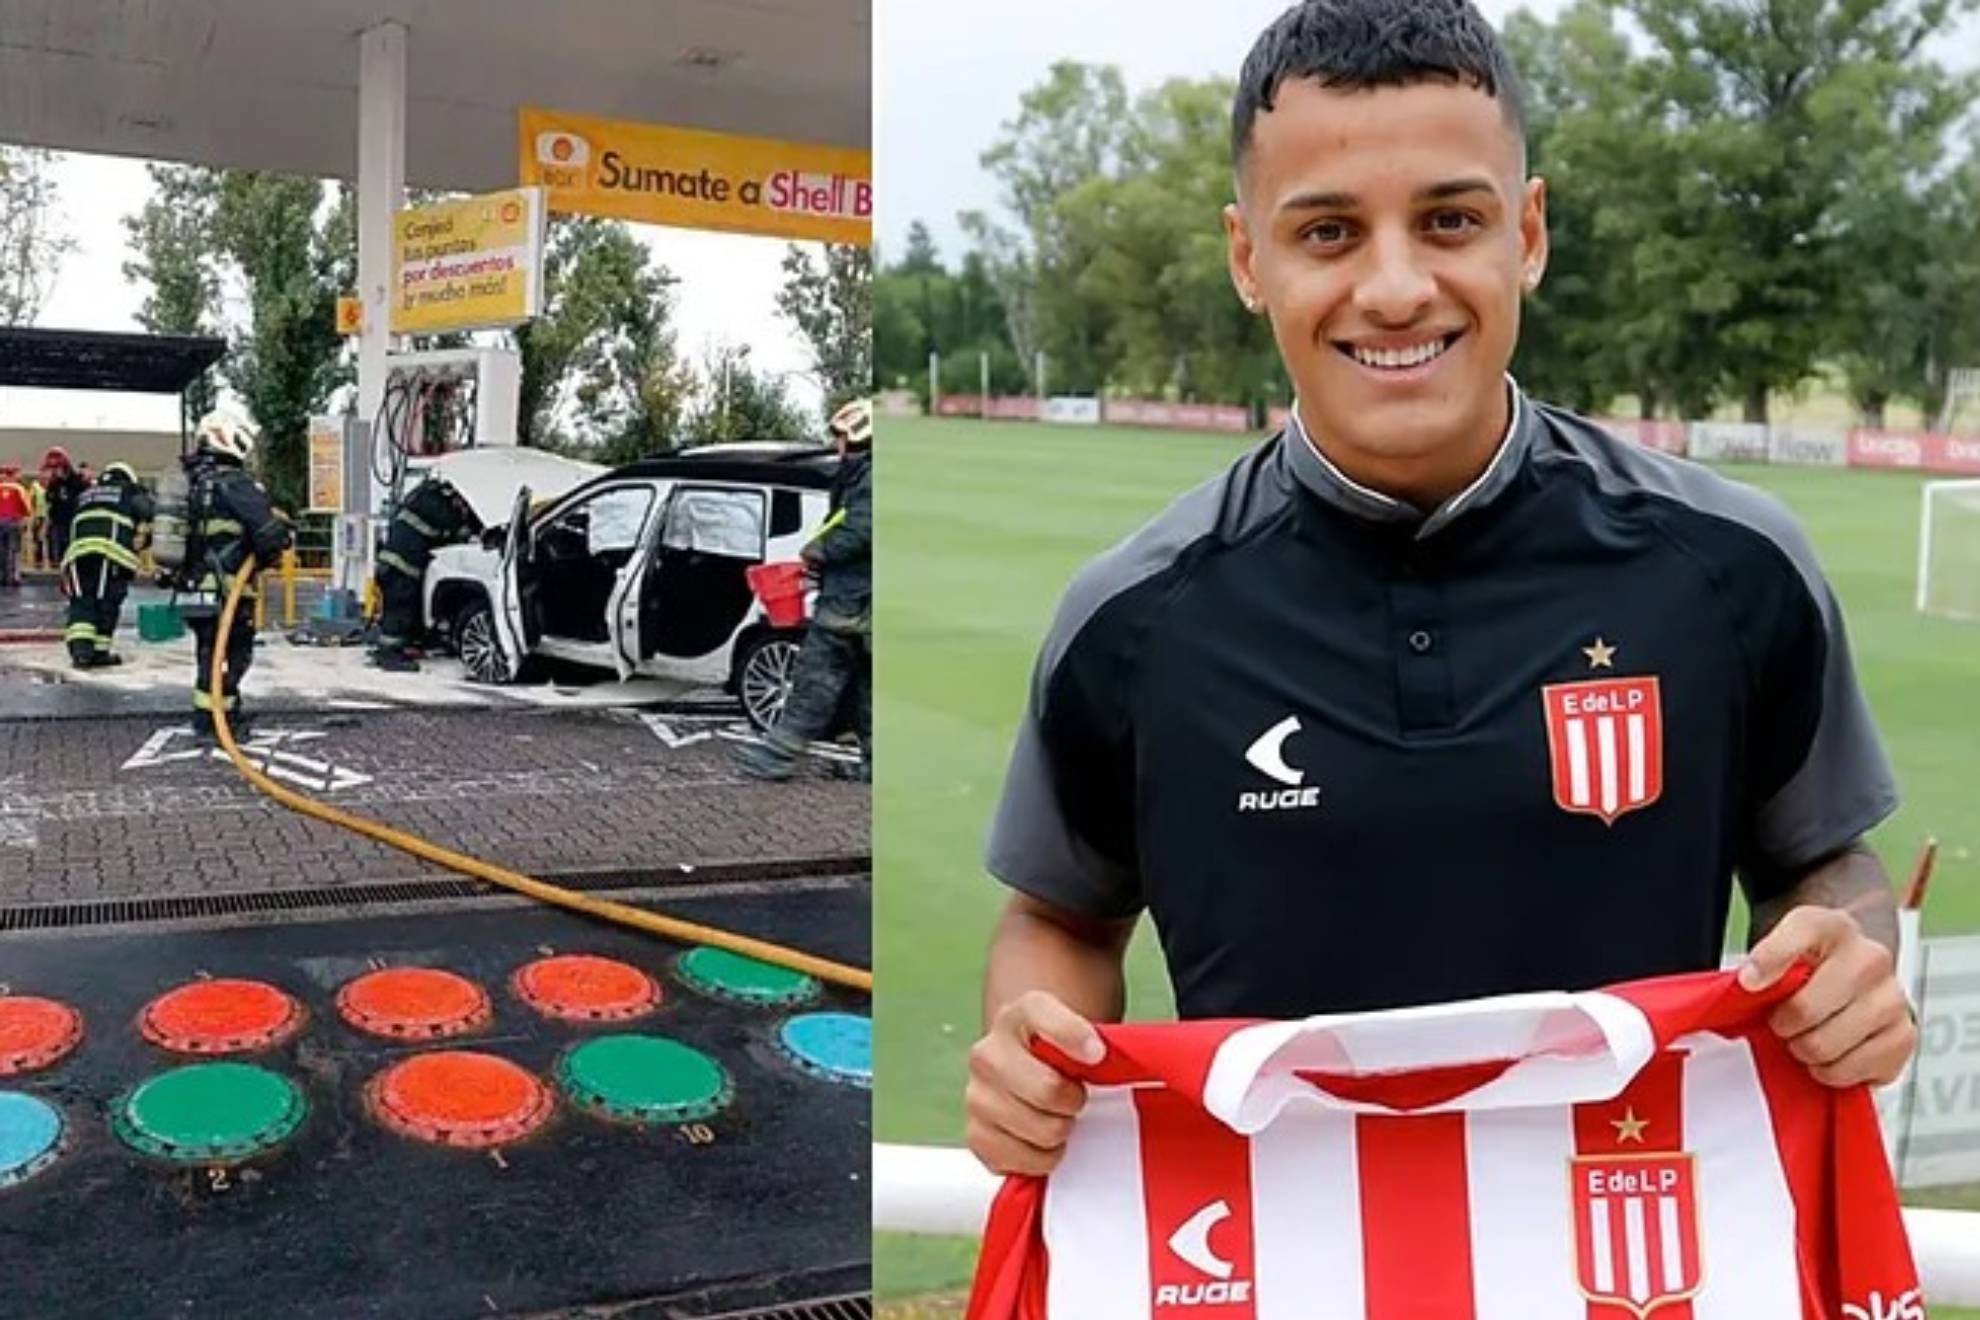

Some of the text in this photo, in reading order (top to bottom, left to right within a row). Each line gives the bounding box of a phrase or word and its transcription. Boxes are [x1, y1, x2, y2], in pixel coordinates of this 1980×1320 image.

[599, 151, 730, 202] Sumate
[738, 180, 761, 205] a
[770, 169, 846, 214] Shell
[425, 239, 477, 264] puntos
[403, 256, 515, 288] por descuentos
[418, 281, 467, 303] mucho
[1238, 786, 1321, 812] RUGE
[207, 1168, 231, 1192] 2
[1156, 1281, 1252, 1306] RUGE
